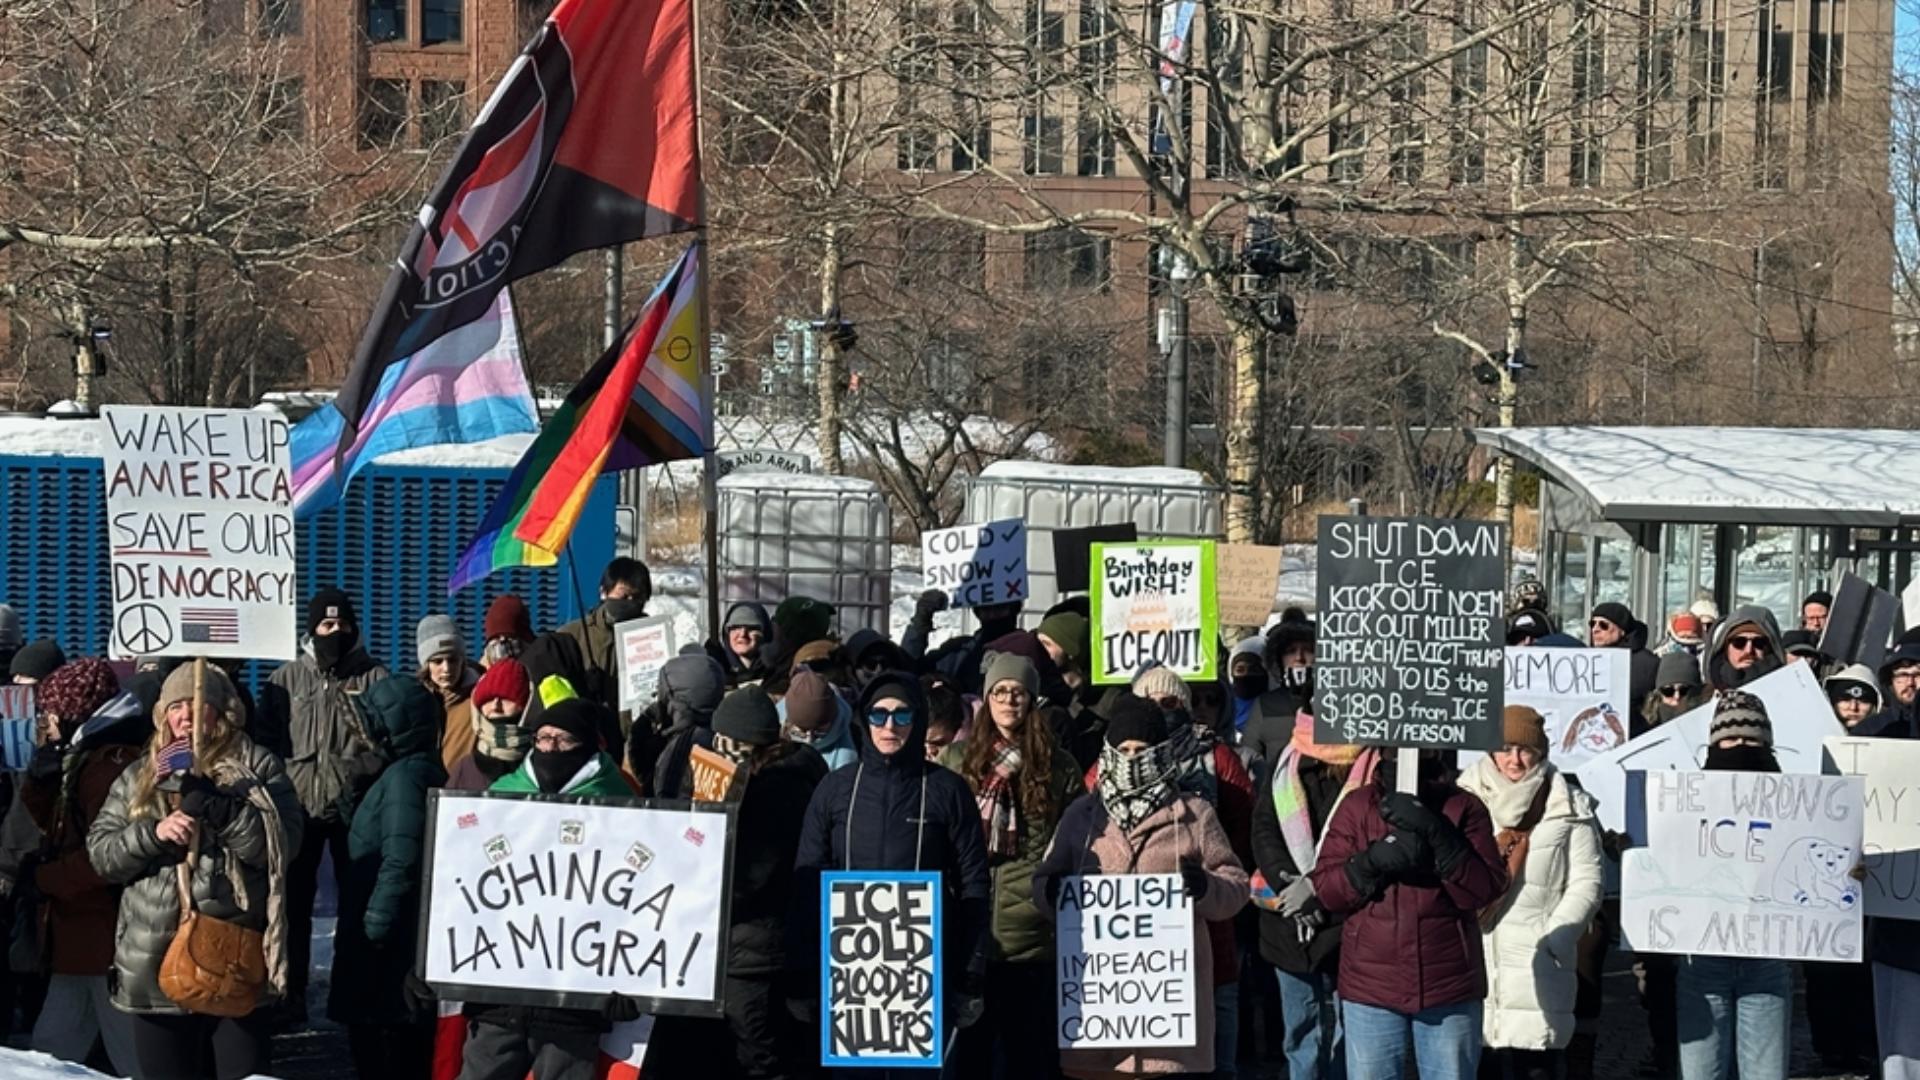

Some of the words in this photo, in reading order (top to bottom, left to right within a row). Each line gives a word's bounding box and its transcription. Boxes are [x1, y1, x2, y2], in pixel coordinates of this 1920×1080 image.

[107, 411, 230, 456] WAKE
[243, 416, 289, 464] UP
[109, 460, 291, 501] AMERICA
[720, 452, 762, 475] GRAND
[767, 454, 802, 474] ARMY
[113, 512, 208, 554] SAVE
[222, 512, 294, 560] OUR
[928, 527, 994, 555] COLD
[1330, 522, 1408, 558] SHUT
[1417, 525, 1499, 556] DOWN
[114, 563, 295, 605] DEMOCRACY!
[927, 560, 994, 586] SNOW
[1105, 557, 1193, 578] Birthday
[949, 582, 994, 608] ICE
[1109, 575, 1186, 598] WISH:
[1329, 586, 1385, 611] KICK
[1391, 587, 1442, 613] OUT
[1449, 590, 1503, 618] NOEM
[1320, 611, 1372, 637] KICK
[1376, 613, 1419, 639] OUT
[1424, 614, 1491, 642] MILLER
[1459, 648, 1503, 668] TRUMP
[1317, 666, 1386, 689] RETURN
[1397, 667, 1421, 690] TO
[1425, 667, 1450, 691] US
[1455, 672, 1489, 693] the
[1321, 690, 1385, 728] $180
[1389, 692, 1404, 720] B
[1407, 700, 1447, 722] from
[1452, 697, 1488, 721] ICE
[1841, 742, 1870, 777] I
[1732, 773, 1850, 823] WRONG
[1698, 818, 1772, 863] ICE
[832, 881, 931, 926] ICE
[1060, 877, 1187, 911] ABOLISH
[830, 920, 934, 966] COLD
[1094, 914, 1153, 940] ICE
[1649, 905, 1681, 950] IS
[448, 925, 501, 973] LA
[507, 914, 703, 988] MIGRA!
[1062, 949, 1187, 979] IMPEACH
[830, 963, 934, 1010] BLOODED
[1061, 978, 1184, 1008] REMOVE
[830, 1008, 934, 1057] KILLERS
[1061, 1012, 1191, 1042] CONVICT
